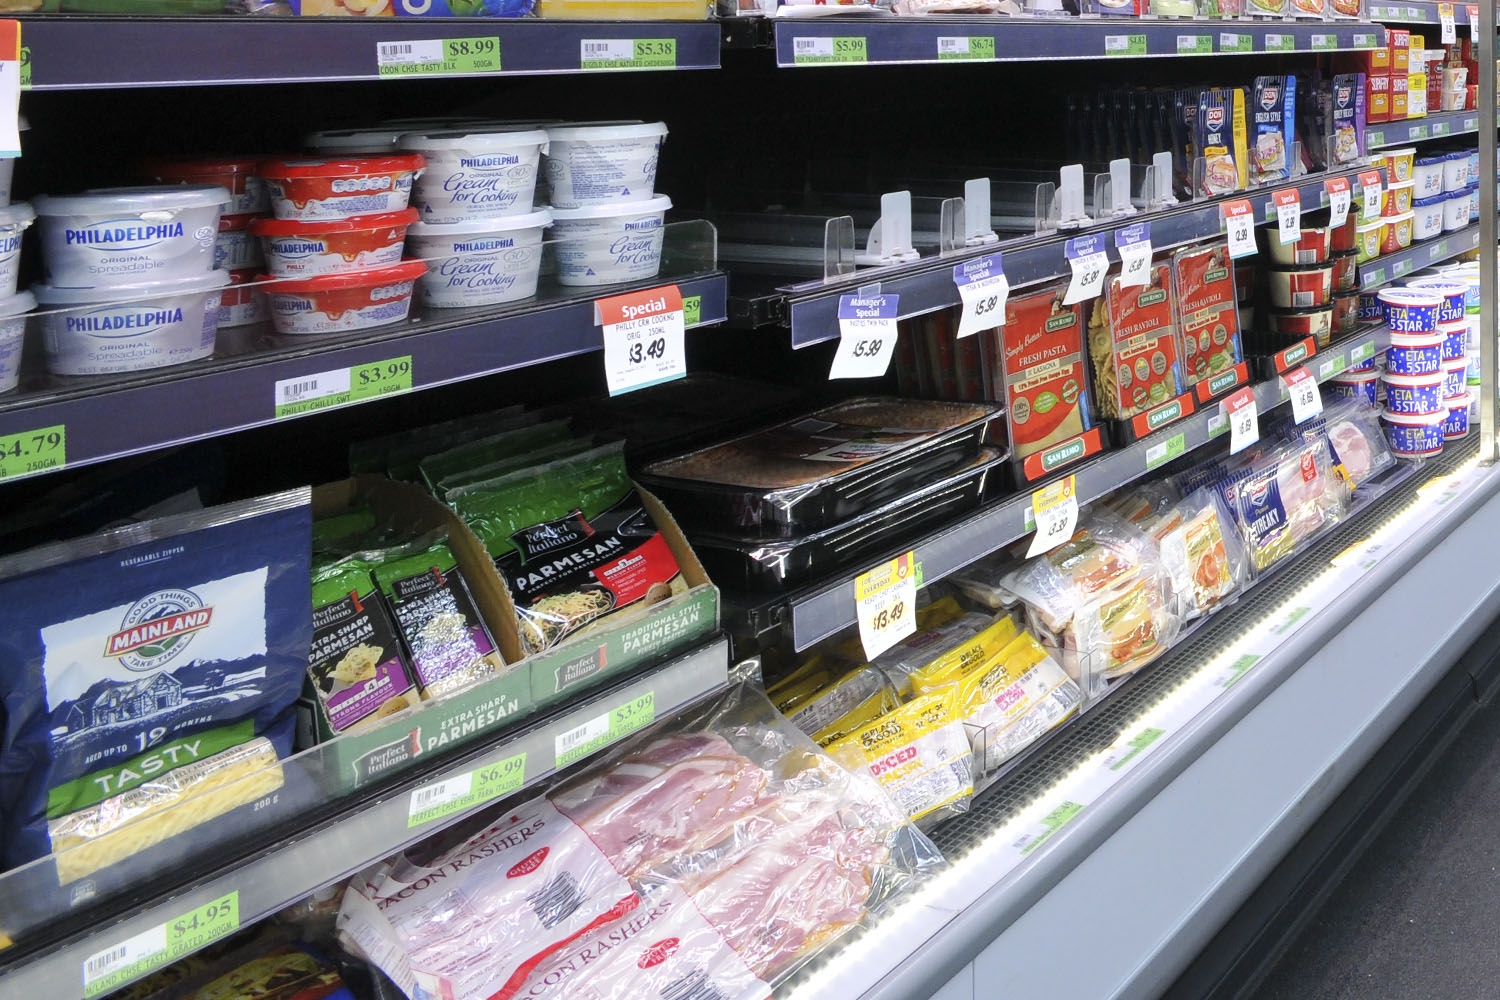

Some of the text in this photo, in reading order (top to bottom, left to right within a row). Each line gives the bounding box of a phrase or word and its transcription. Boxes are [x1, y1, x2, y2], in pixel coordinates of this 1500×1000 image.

[449, 39, 495, 58] $8.99
[636, 42, 673, 57] $5.38
[835, 39, 863, 53] $5.99
[970, 38, 994, 51] $6.74
[460, 154, 520, 168] PHILADELPHIA
[443, 172, 498, 191] Cream
[449, 188, 519, 206] for Cooking
[65, 221, 185, 246] PHILADELPHIA
[453, 237, 515, 253] PHILADELPHIA
[609, 236, 653, 254] Cream
[87, 259, 165, 275] Spreadable
[100, 255, 152, 265] ORIGINAL
[446, 273, 517, 290] for Cooking
[621, 297, 667, 319] Special
[849, 296, 887, 309] Manager's
[855, 306, 881, 319] Special
[1389, 307, 1409, 320] ETA
[65, 307, 184, 332] PHILADELPHIA
[1390, 318, 1423, 332] 5 STAR
[87, 346, 163, 362] Spreadable
[628, 337, 666, 365] $3.49
[852, 338, 883, 358] $5.99
[1018, 344, 1068, 368] FRESH PASTA
[1405, 350, 1425, 362] ETA
[358, 361, 410, 386] $3.99
[1032, 360, 1058, 376] LASAGNA
[1405, 357, 1438, 372] 5 STAR
[281, 395, 351, 417] PHILLY CHILLI SWT
[1394, 390, 1413, 401] ETA
[1405, 427, 1425, 440] ETA
[1413, 436, 1438, 451] STAR
[26, 457, 58, 474] 250GM
[1046, 444, 1081, 466] SAN REMO
[1252, 508, 1279, 536] STREAKY
[120, 545, 186, 569] RESEALABLE ZIPPER
[515, 535, 621, 592] PARMESAN
[128, 590, 197, 625] GOOD THINGS
[872, 601, 904, 632] $13.49
[110, 610, 211, 654] MAINLAND
[337, 615, 371, 638] SHARP
[621, 602, 702, 642] TRADITIONAL STYLE
[622, 611, 701, 654] PARMESAN
[129, 641, 187, 669] TAKE TIME
[564, 654, 594, 674] Perfect
[439, 694, 507, 731] EXTRA SHARP
[615, 694, 653, 723] $3.99
[427, 698, 519, 751] PARMESAN
[84, 750, 104, 766] AGED
[103, 746, 116, 760] UP
[116, 743, 129, 755] TO
[173, 713, 213, 733] MONTHS
[94, 740, 203, 795] TASTY
[367, 751, 409, 776] Italiano
[479, 757, 523, 786] $6.99
[869, 745, 918, 777] DICED
[452, 818, 546, 872] RASHERS
[172, 899, 232, 939] $4.95
[580, 899, 672, 964] RASHERS
[85, 921, 233, 996] M/LAND CHSE TASTY GRATED 200GM
